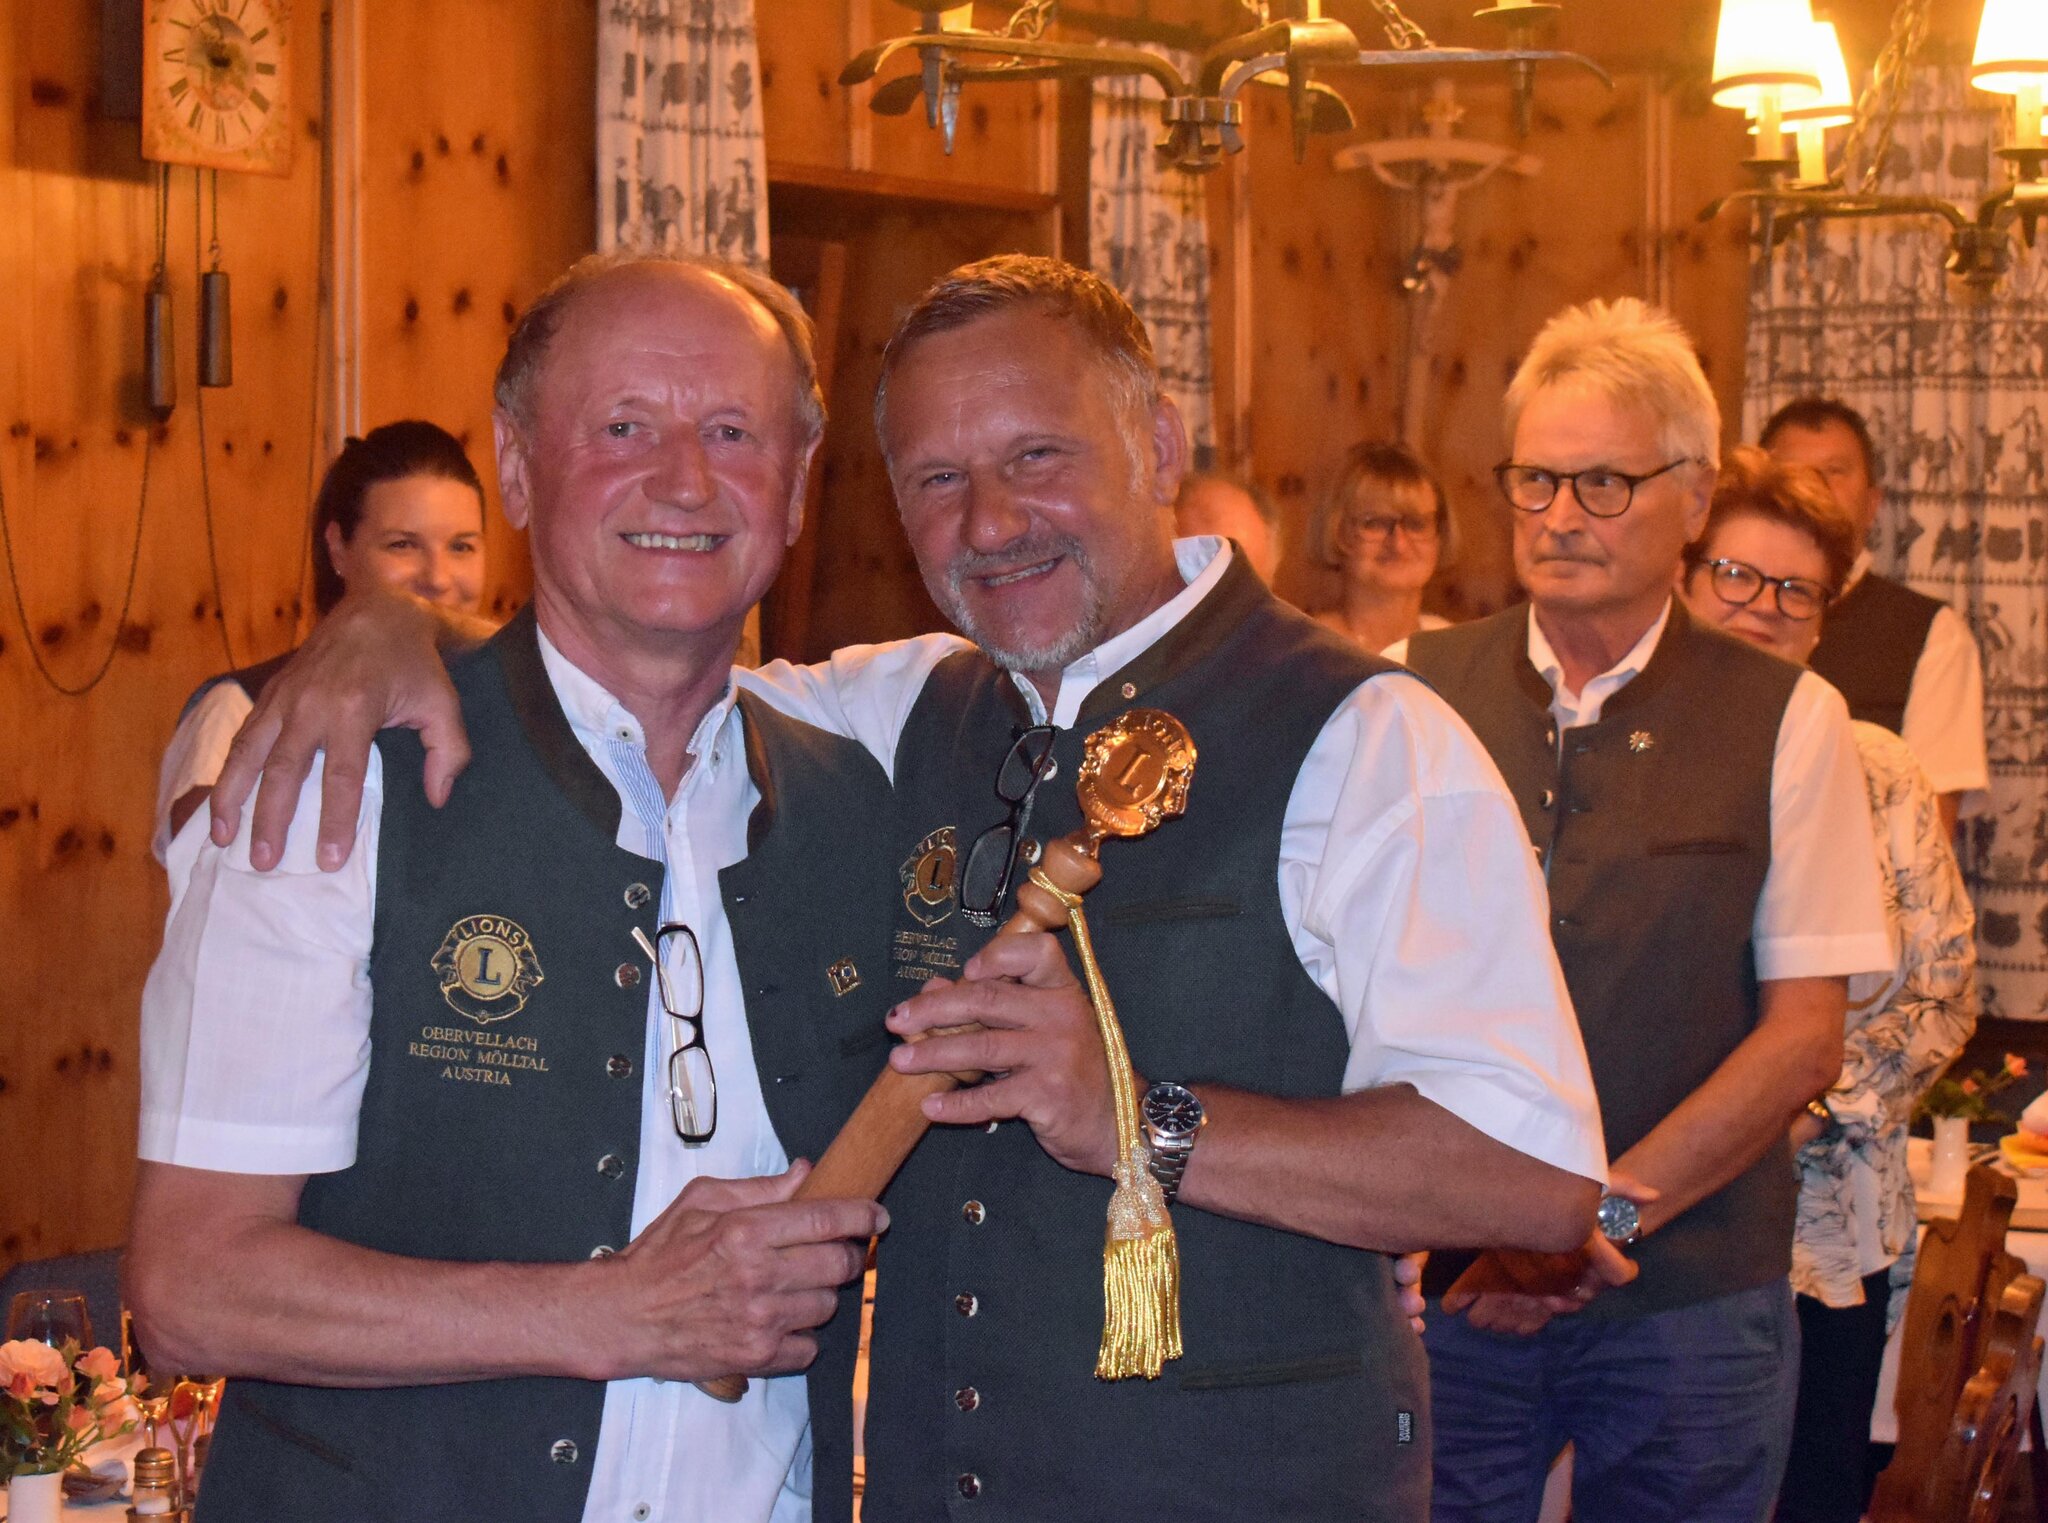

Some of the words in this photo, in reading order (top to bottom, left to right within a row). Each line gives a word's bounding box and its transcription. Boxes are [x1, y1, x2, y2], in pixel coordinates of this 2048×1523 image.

[928, 856, 944, 890] L
[460, 918, 522, 945] LIONS
[474, 947, 502, 986] L
[422, 1026, 538, 1052] OBERVELLACH
[409, 1042, 470, 1061] REGION
[477, 1050, 549, 1072] MÖLLTAL
[442, 1066, 512, 1086] AUSTRIA
